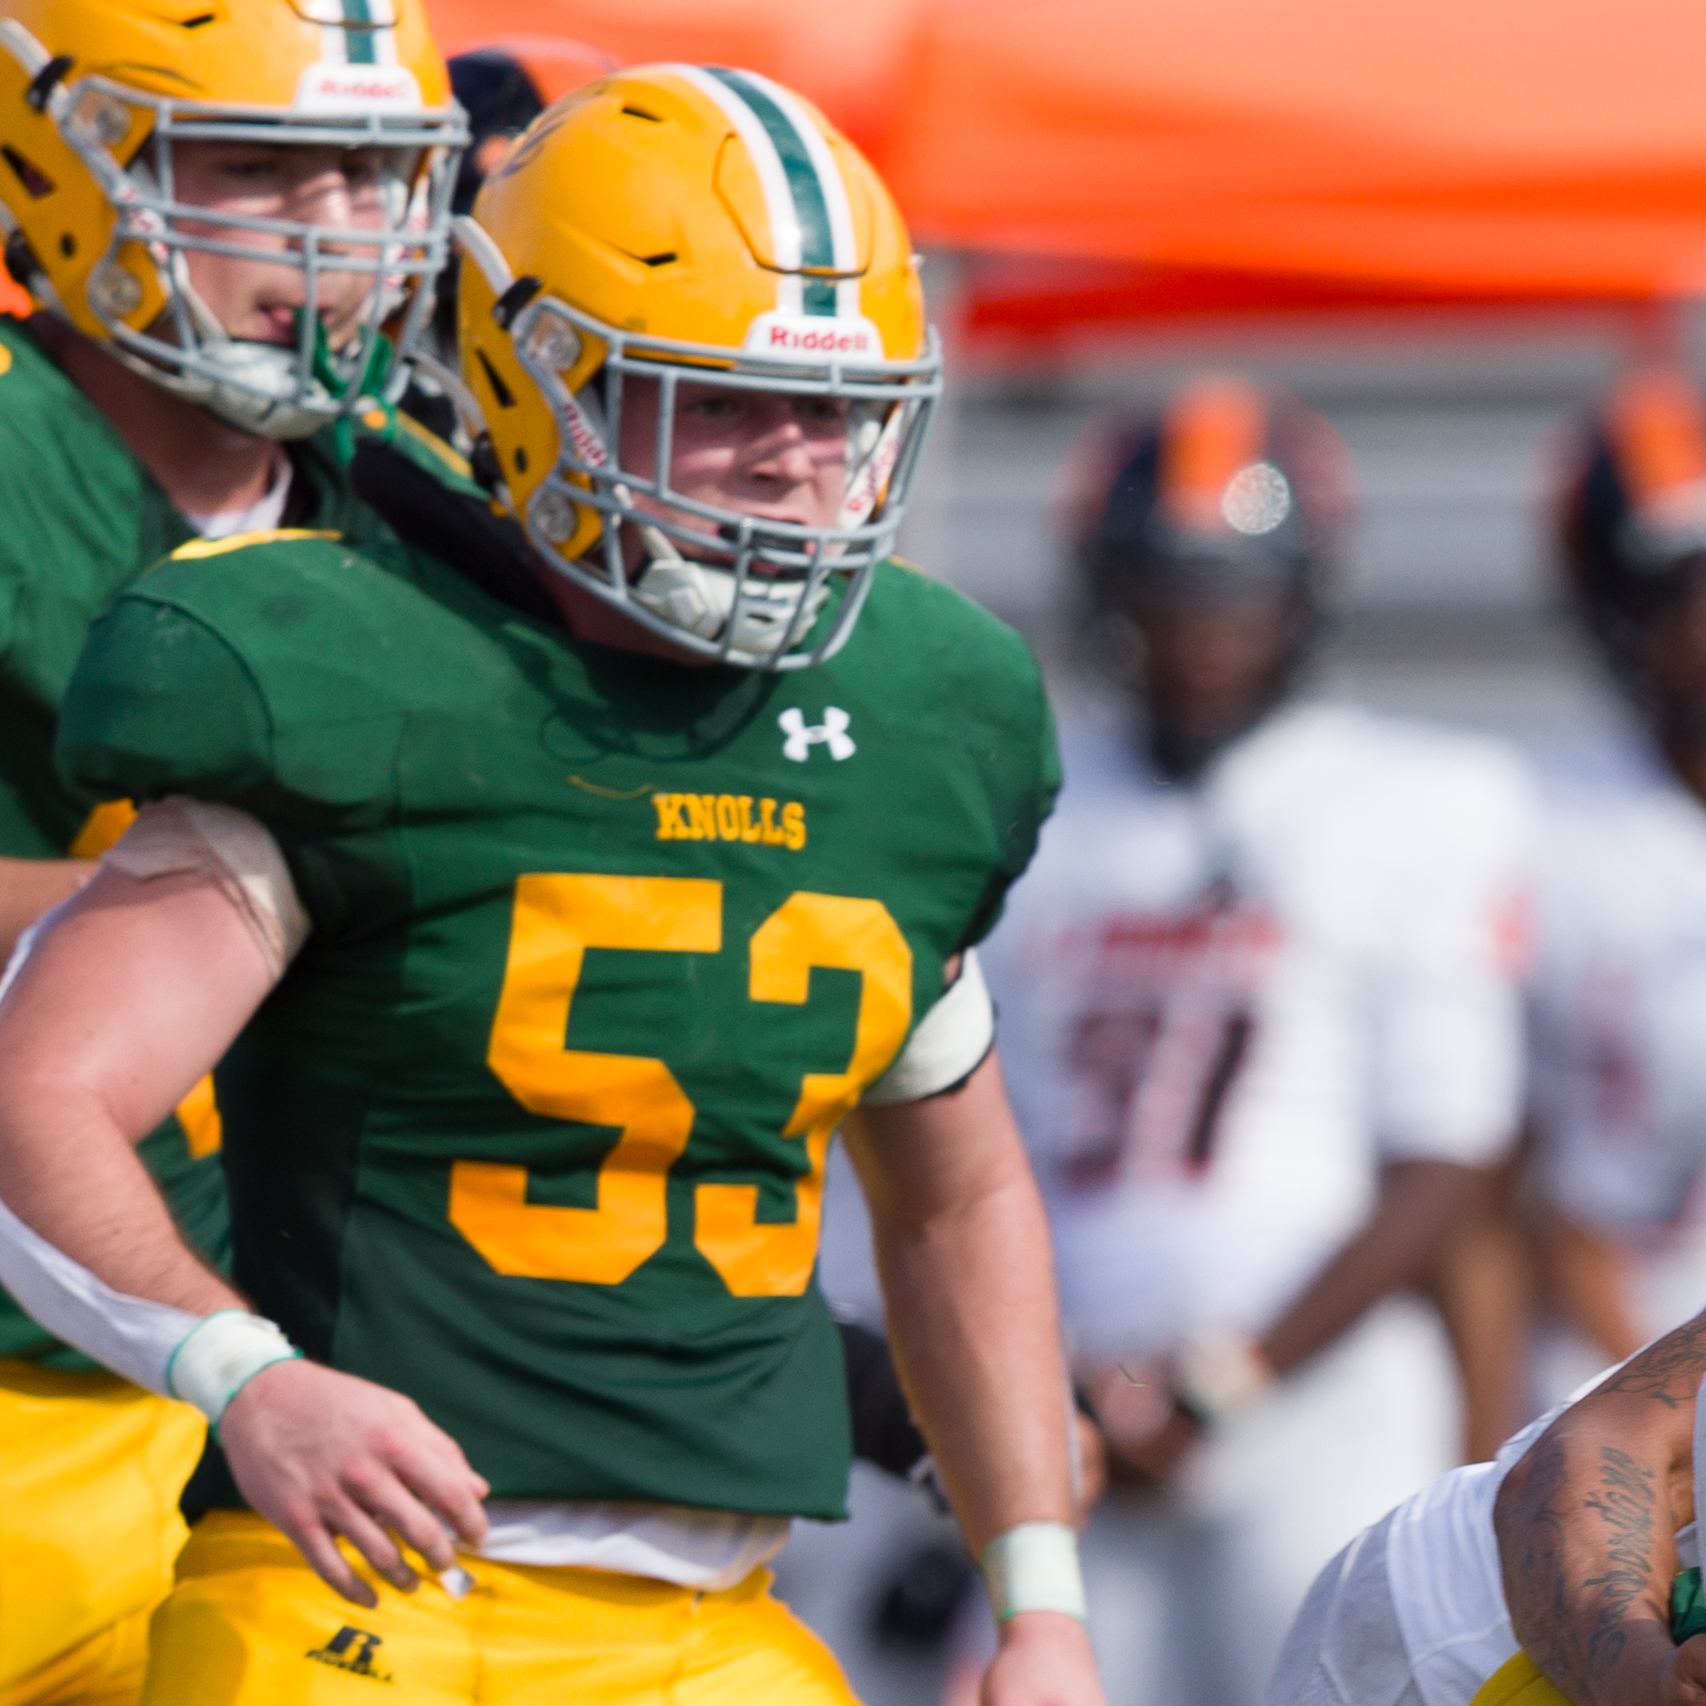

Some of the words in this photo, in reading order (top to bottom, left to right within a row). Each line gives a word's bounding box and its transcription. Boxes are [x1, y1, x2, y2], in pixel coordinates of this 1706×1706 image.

[769, 325, 868, 351] Riddell
[653, 792, 806, 850] KNOLLS
[449, 873, 912, 1297] 53
